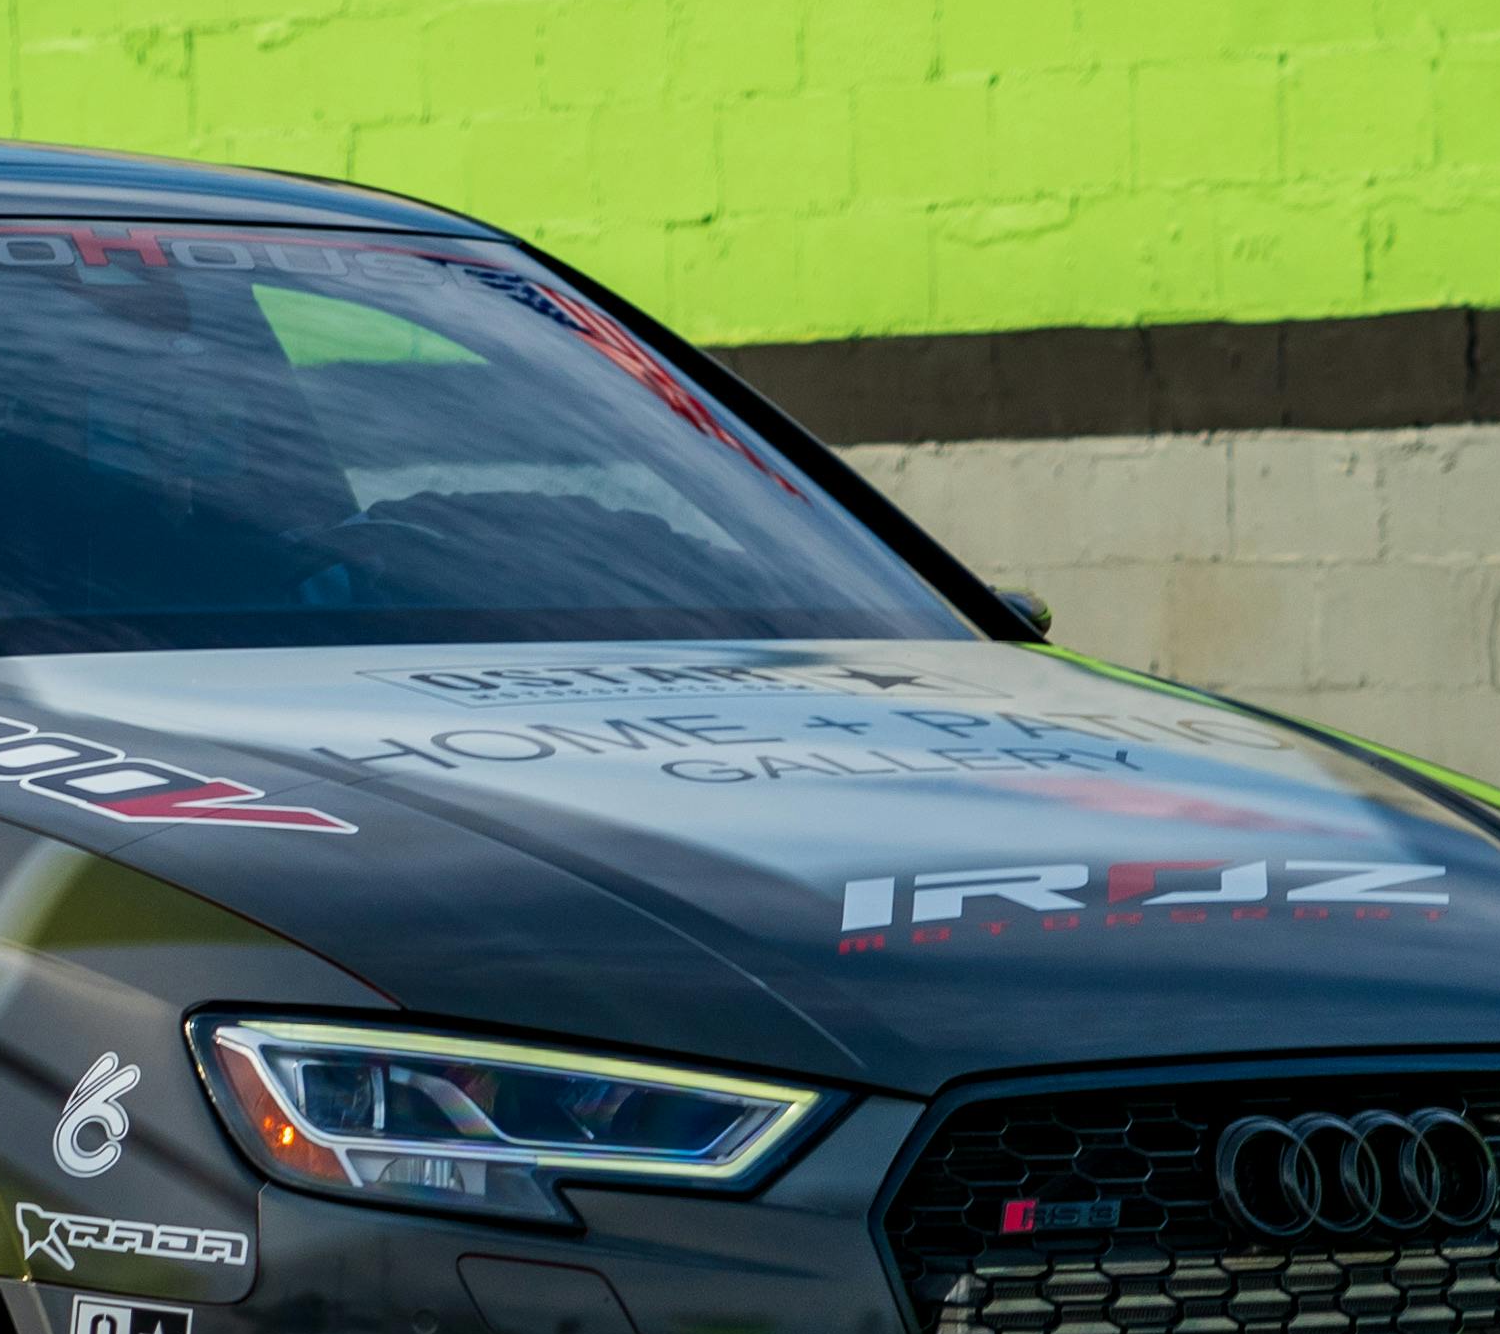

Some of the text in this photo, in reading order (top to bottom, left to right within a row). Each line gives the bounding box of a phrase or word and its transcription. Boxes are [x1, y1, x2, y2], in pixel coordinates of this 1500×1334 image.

[310, 714, 787, 769] HOME
[890, 709, 1301, 752] PATIO
[660, 748, 1144, 783] GALLERY
